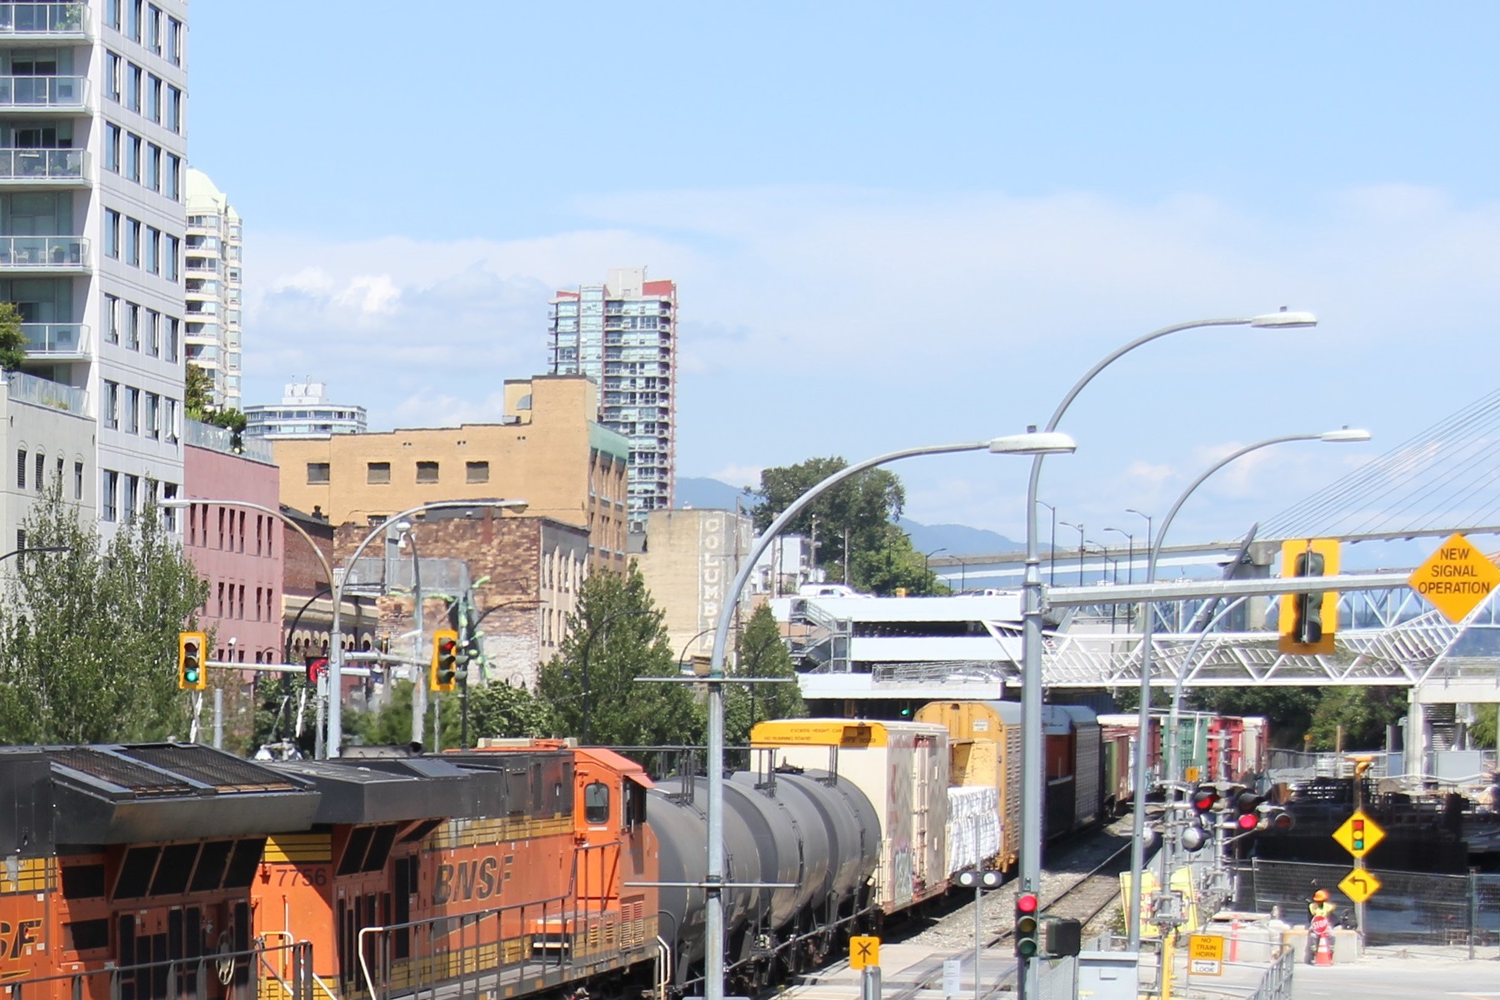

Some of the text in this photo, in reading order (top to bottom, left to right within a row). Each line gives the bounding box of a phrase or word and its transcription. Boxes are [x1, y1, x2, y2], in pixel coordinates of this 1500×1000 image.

[1440, 548, 1470, 560] NEW
[1431, 565, 1478, 577] SIGNAL
[704, 519, 720, 649] COLUMBIA
[1418, 582, 1490, 594] OPERATION
[276, 867, 327, 887] 7756
[433, 854, 515, 907] BNSF
[1312, 919, 1328, 929] STOP
